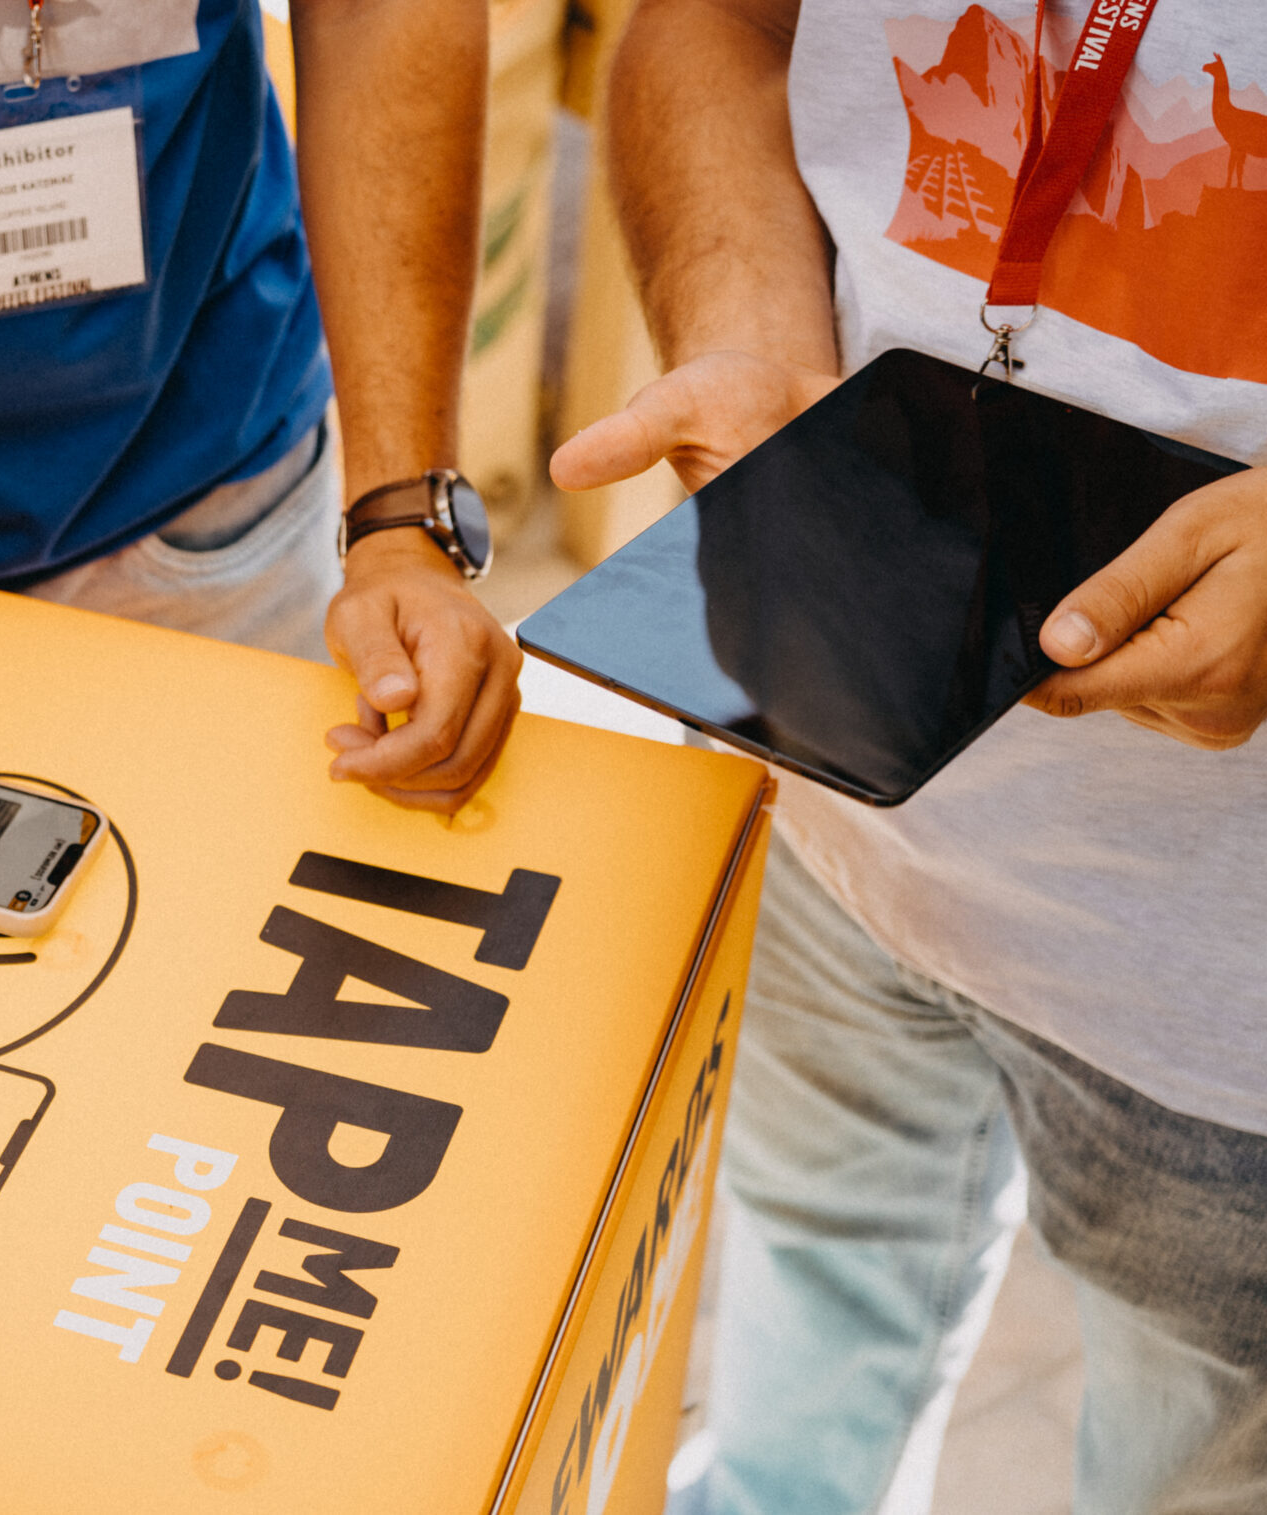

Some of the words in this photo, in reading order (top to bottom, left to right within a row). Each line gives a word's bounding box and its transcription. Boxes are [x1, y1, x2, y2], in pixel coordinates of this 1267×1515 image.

[1074, 0, 1125, 71] STIVAL
[1119, 0, 1150, 31] NS
[14, 269, 61, 286] ATHENS
[183, 850, 563, 1214] TAP
[53, 1132, 240, 1364] POINT
[214, 1217, 401, 1412] ME!
